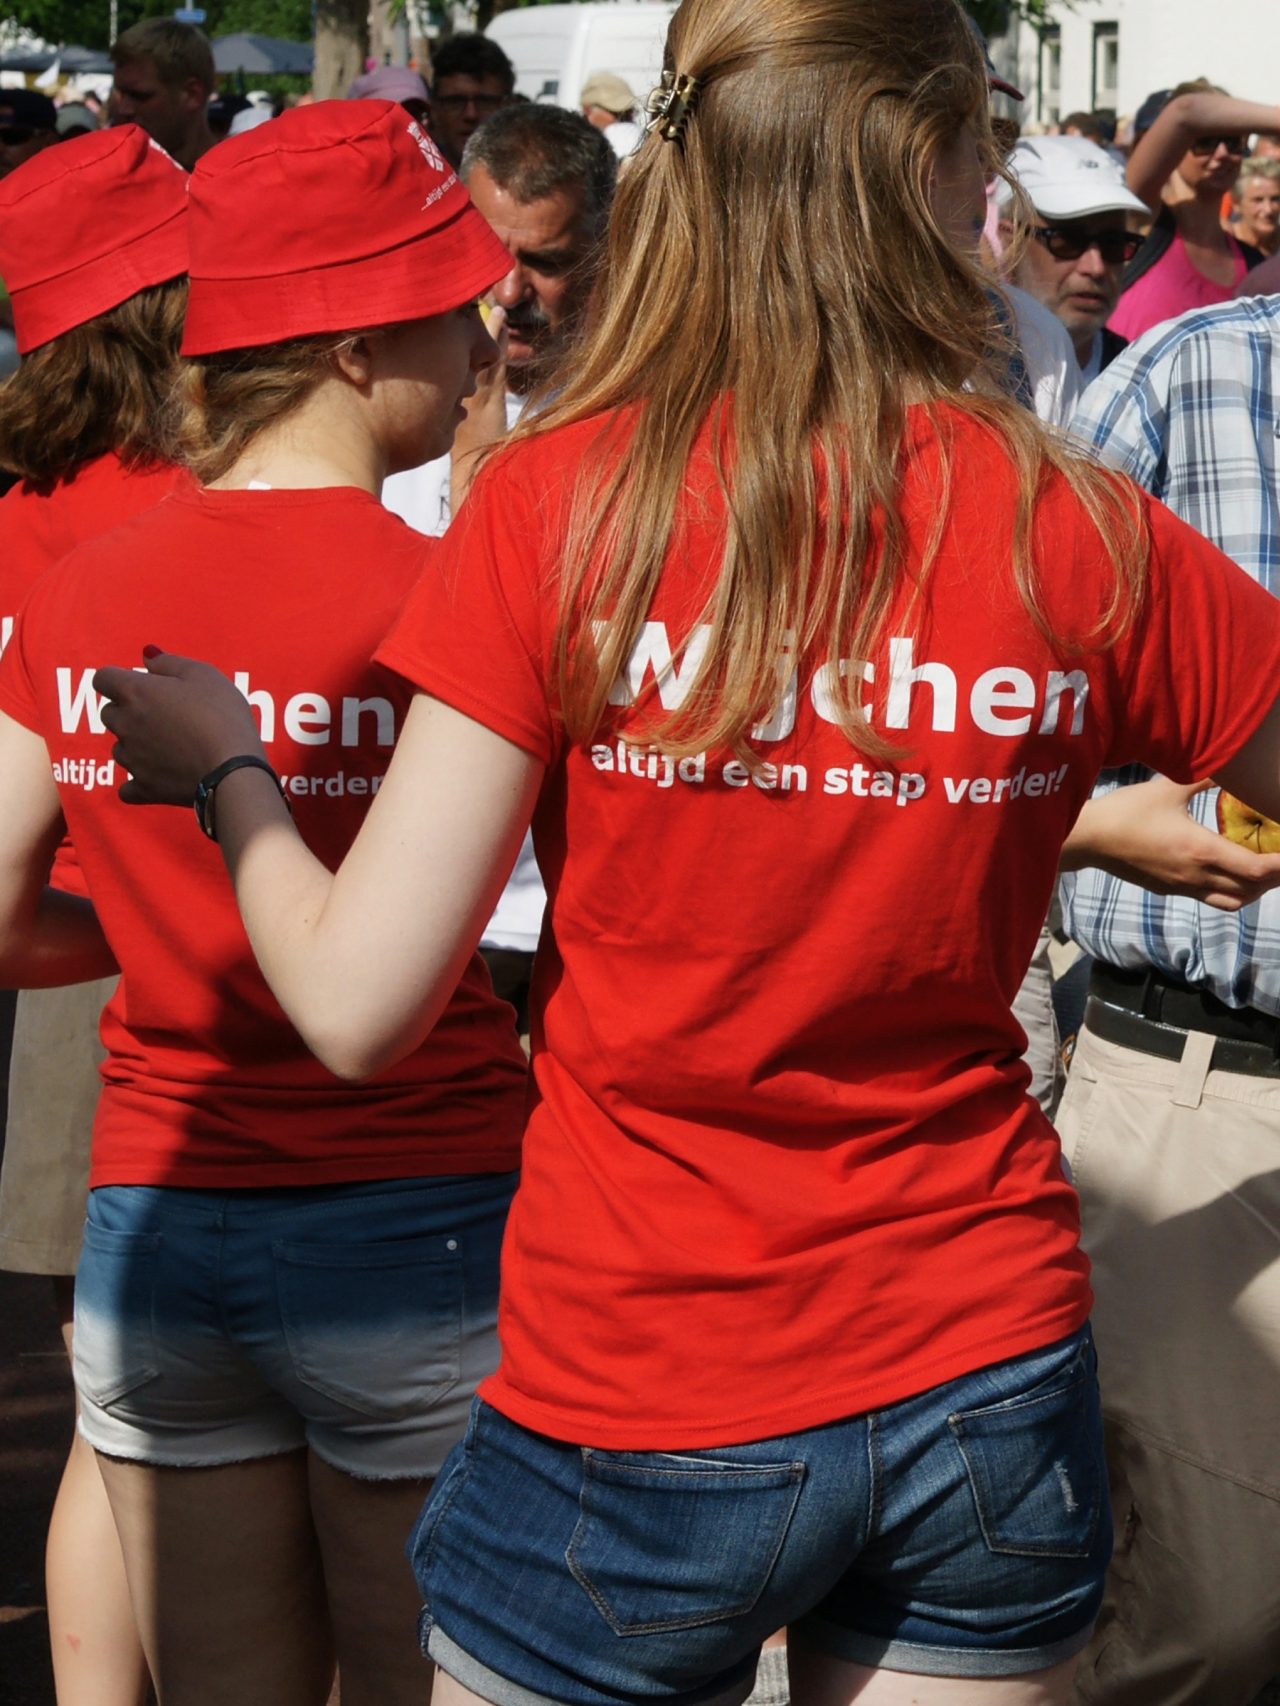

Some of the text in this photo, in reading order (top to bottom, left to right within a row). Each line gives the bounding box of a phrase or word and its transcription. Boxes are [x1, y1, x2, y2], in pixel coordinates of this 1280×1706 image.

[53, 757, 114, 791] altijd
[592, 739, 1068, 807] altijd een stap verder!
